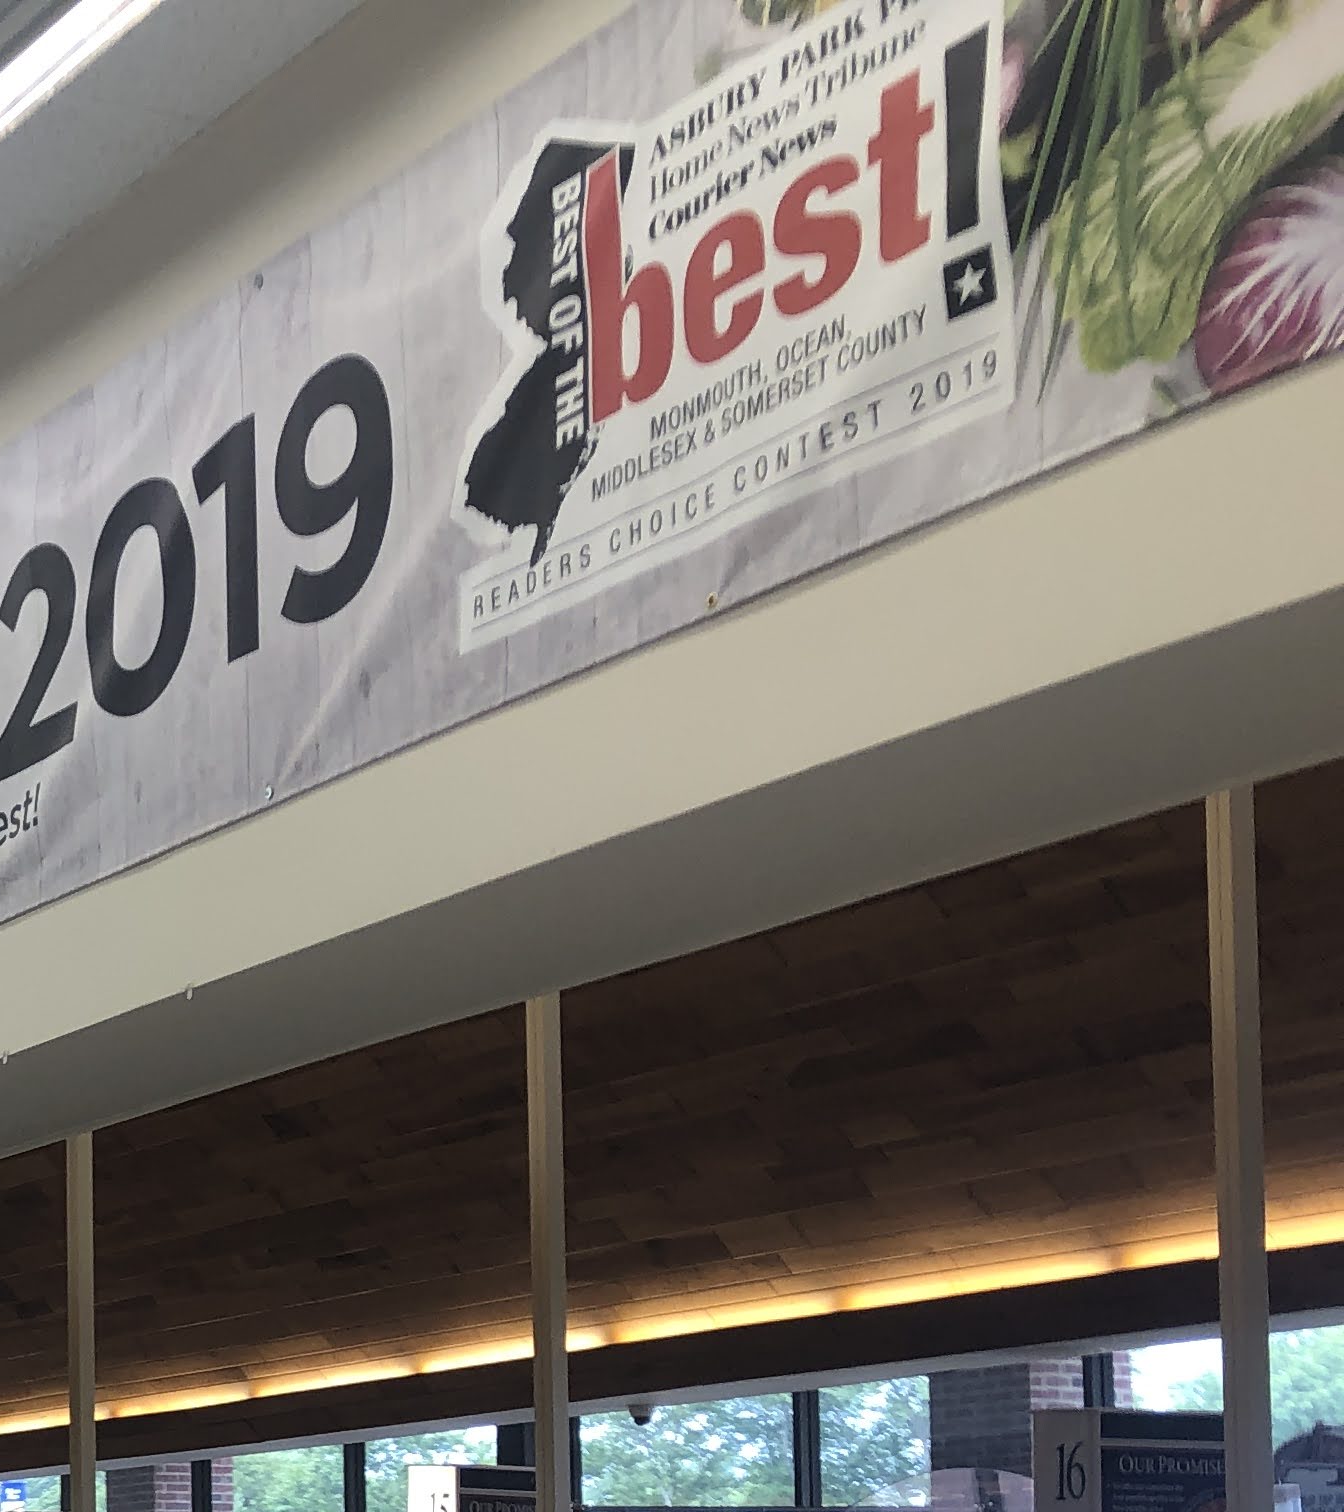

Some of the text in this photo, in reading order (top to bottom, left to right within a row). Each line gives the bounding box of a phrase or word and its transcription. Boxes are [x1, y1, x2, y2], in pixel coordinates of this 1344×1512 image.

[649, 8, 867, 165] ASBURY PARK
[649, 18, 928, 207] Home News Tribune
[649, 114, 839, 242] Courier News
[548, 173, 586, 451] BEST OF THE
[648, 314, 852, 440] MONMOUTH, OCEAN,
[591, 304, 927, 503] MIDDLESEX & SOMERSET COUNTY
[473, 348, 999, 619] READERS CHOICE CONTEST 2019
[1054, 1439, 1087, 1501] 16
[1118, 1452, 1158, 1475] OUR
